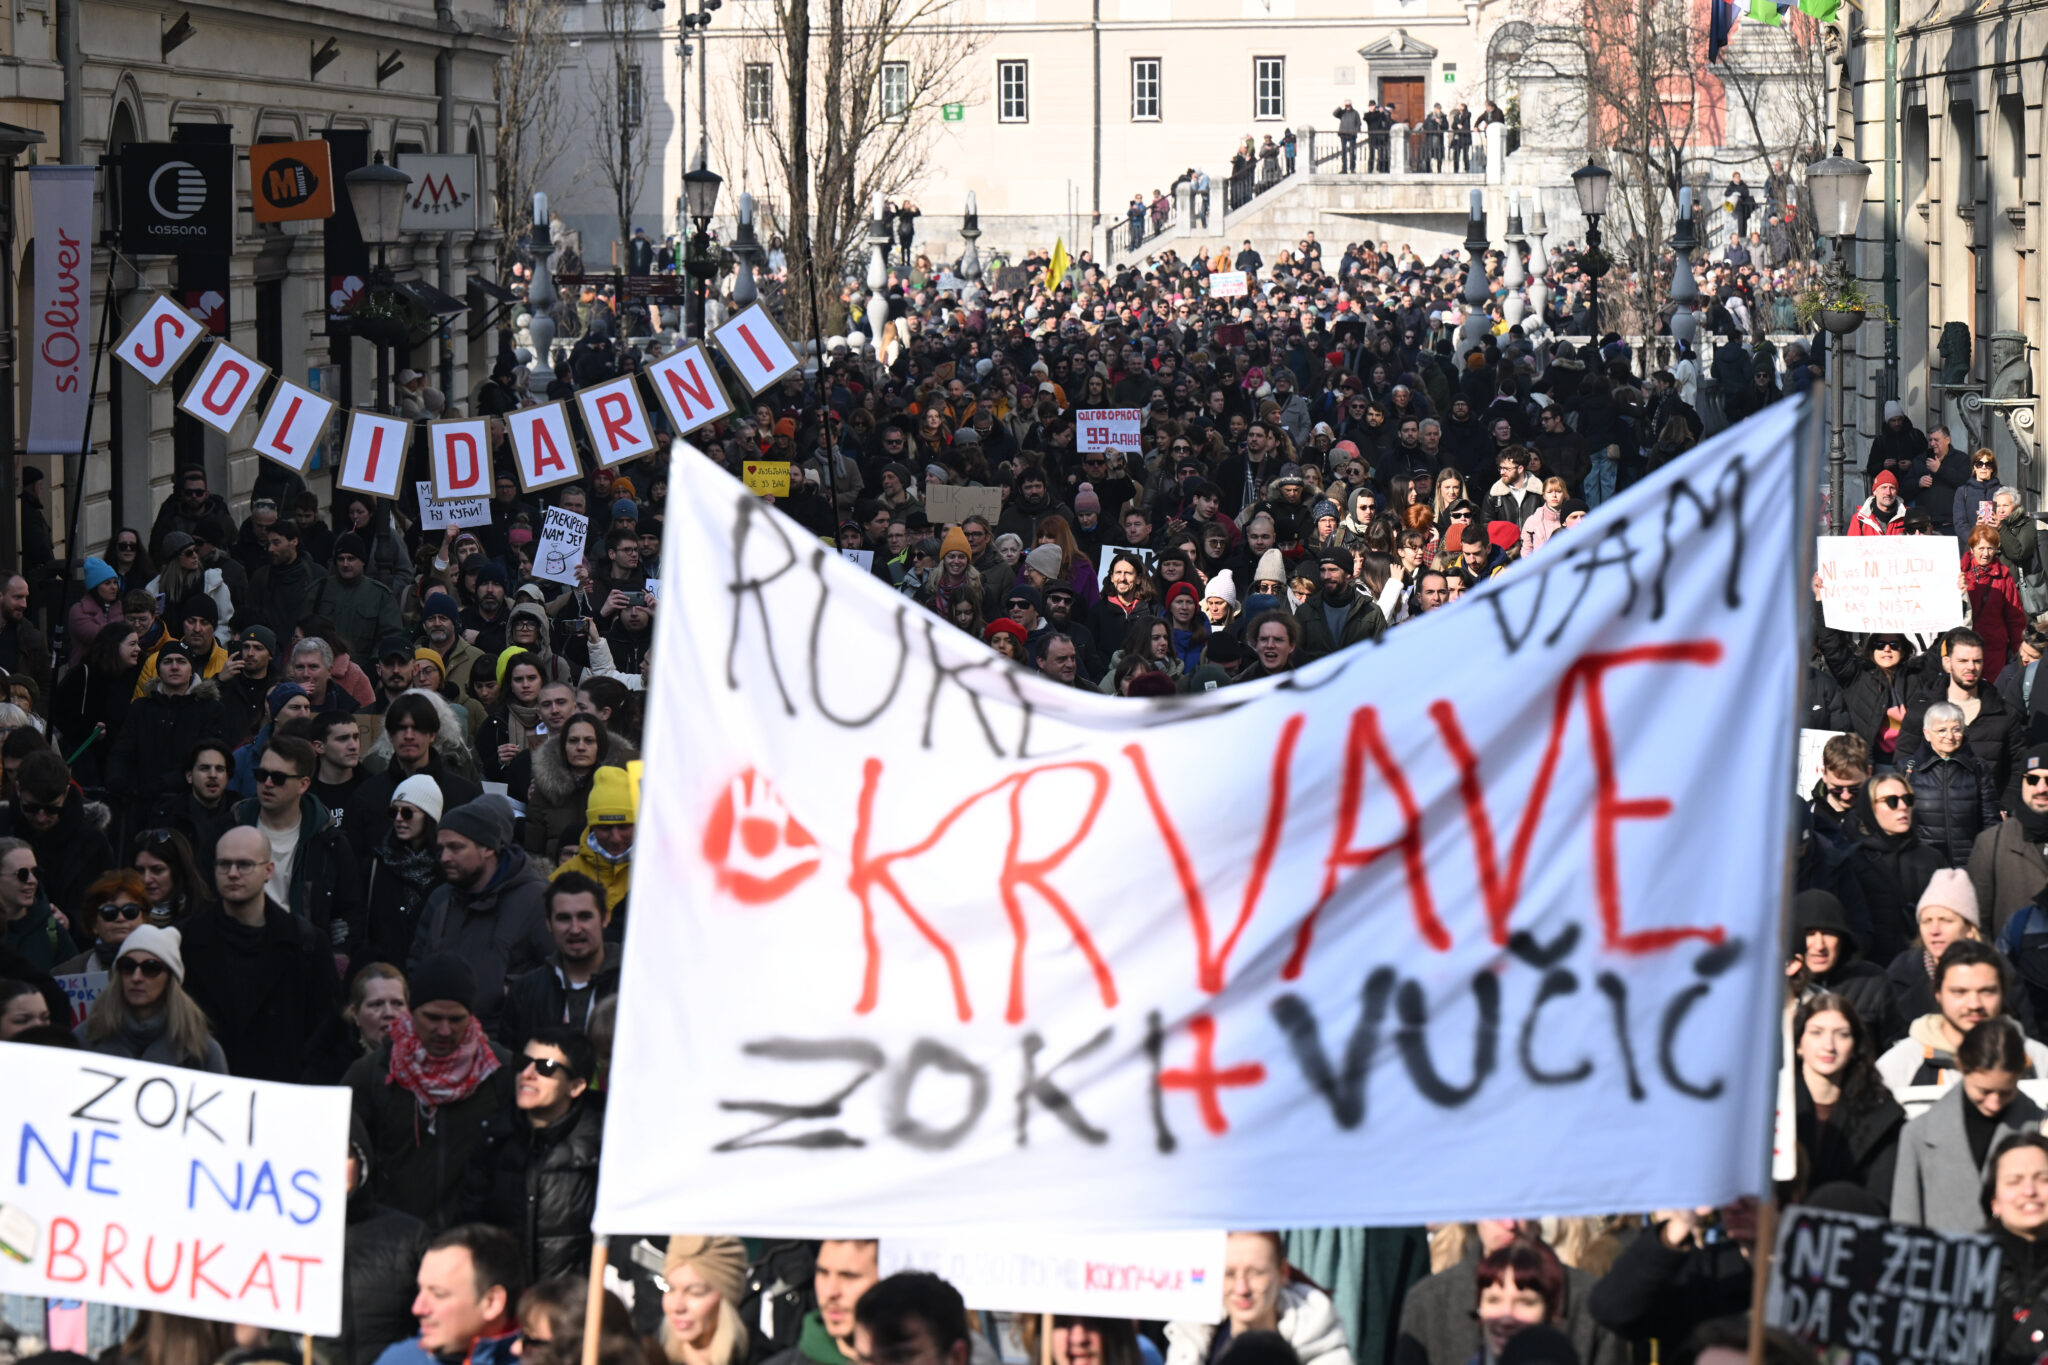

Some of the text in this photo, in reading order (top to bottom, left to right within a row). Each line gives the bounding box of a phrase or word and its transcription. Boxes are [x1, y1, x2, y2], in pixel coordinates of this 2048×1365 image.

[42, 227, 81, 393] s.Oliver
[134, 312, 776, 491] SOLIDARNI
[542, 527, 565, 542] NAM
[846, 639, 1727, 1024] KRVAVE
[711, 1008, 1178, 1157] ZOKI
[1270, 922, 1747, 1132] VUČIĆ
[69, 1065, 257, 1147] ZOKI
[17, 1121, 323, 1226] NE NAS
[45, 1216, 324, 1313] BRUKAT
[1791, 1221, 1857, 1288] NE
[1845, 1291, 1887, 1350] SE
